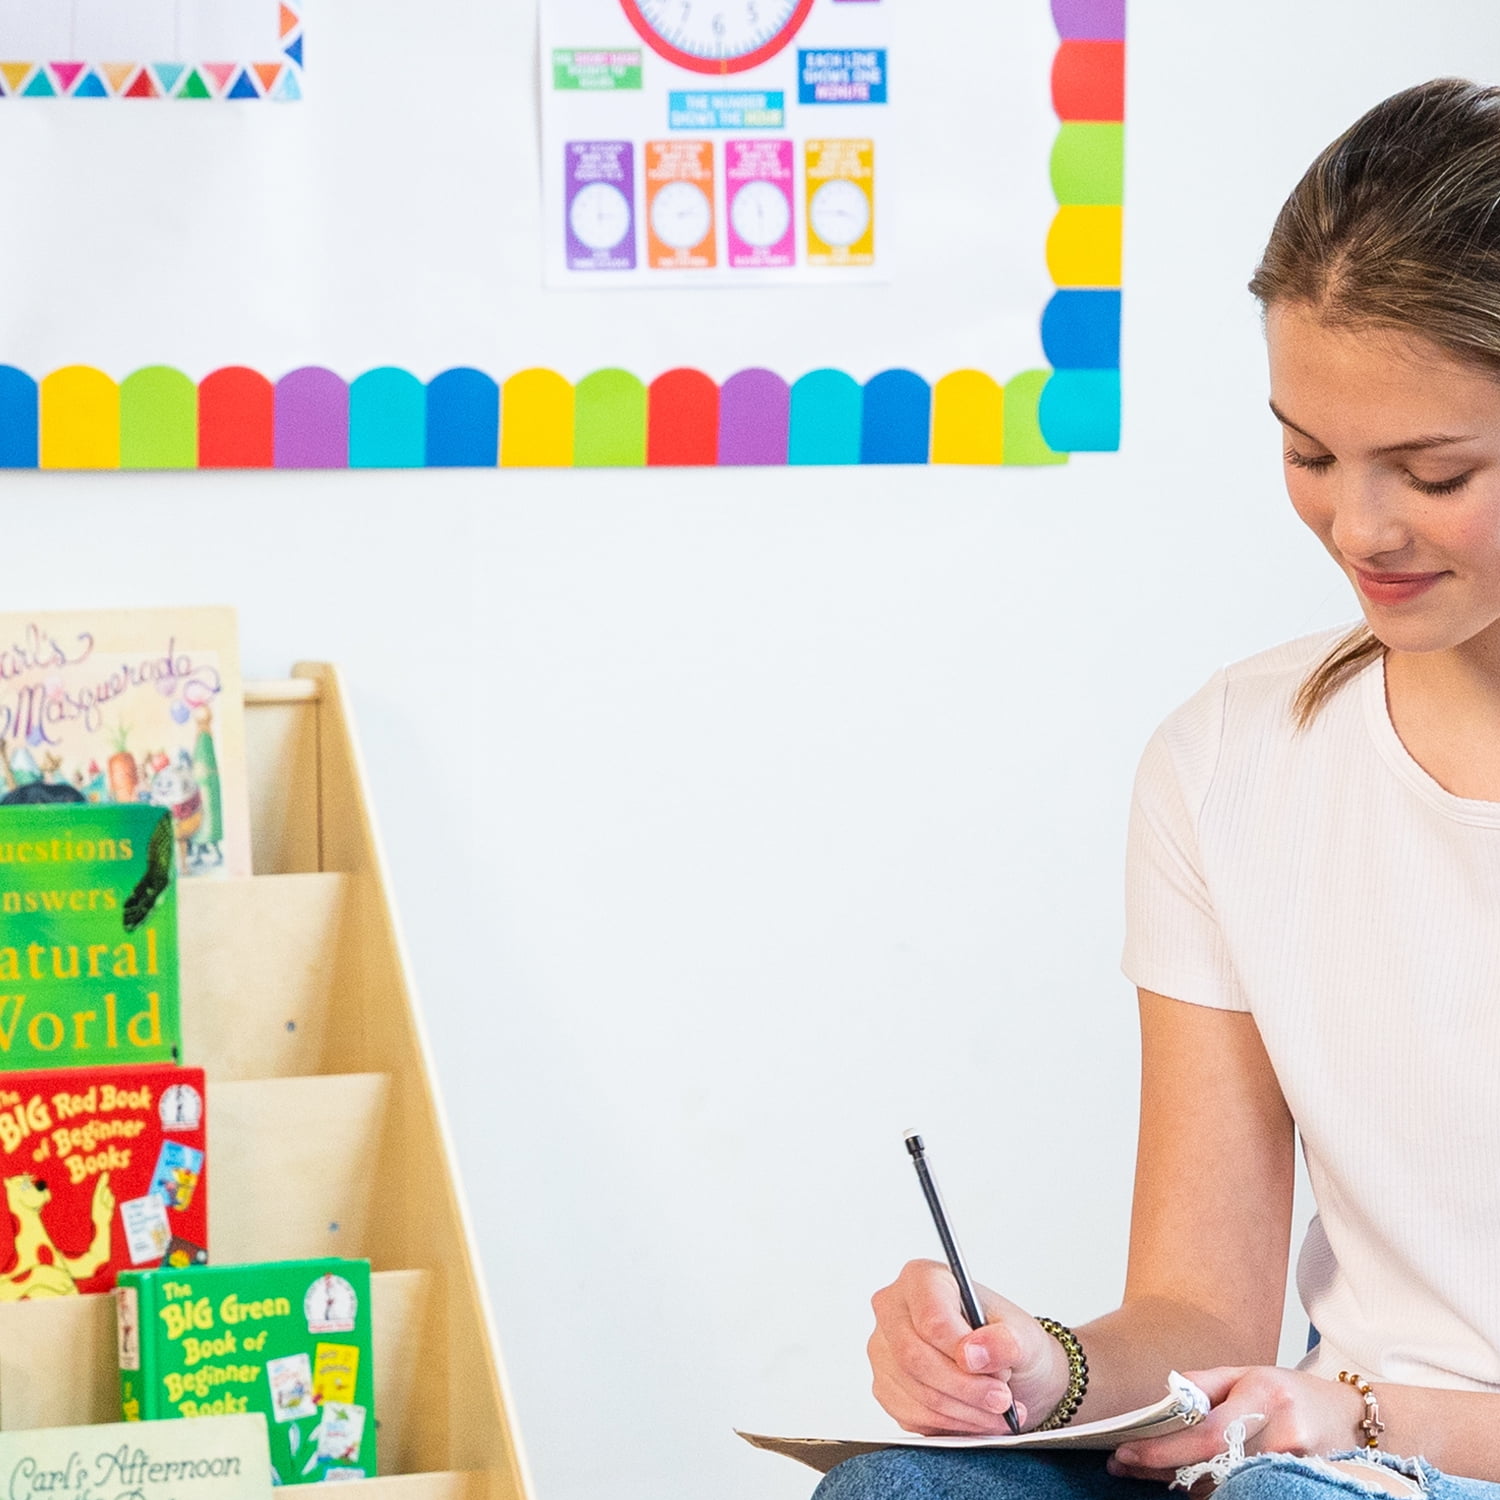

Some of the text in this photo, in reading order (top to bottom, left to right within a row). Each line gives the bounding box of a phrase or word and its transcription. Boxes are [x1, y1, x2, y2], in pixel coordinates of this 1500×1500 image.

[711, 12, 726, 36] 6
[803, 67, 882, 84] SHOWS ONE
[806, 51, 877, 68] EACH LINE
[815, 83, 870, 101] MINUTE
[0, 1085, 152, 1153] BIG Red Book
[32, 1137, 50, 1162] of
[52, 1120, 146, 1158] Beginner
[65, 1144, 131, 1185] Books
[162, 1282, 192, 1301] The
[159, 1294, 290, 1340] BIG Green
[182, 1330, 268, 1366] Book of
[163, 1365, 261, 1403] Beginner
[178, 1391, 248, 1418] Books
[95, 1444, 242, 1488] Afternoon
